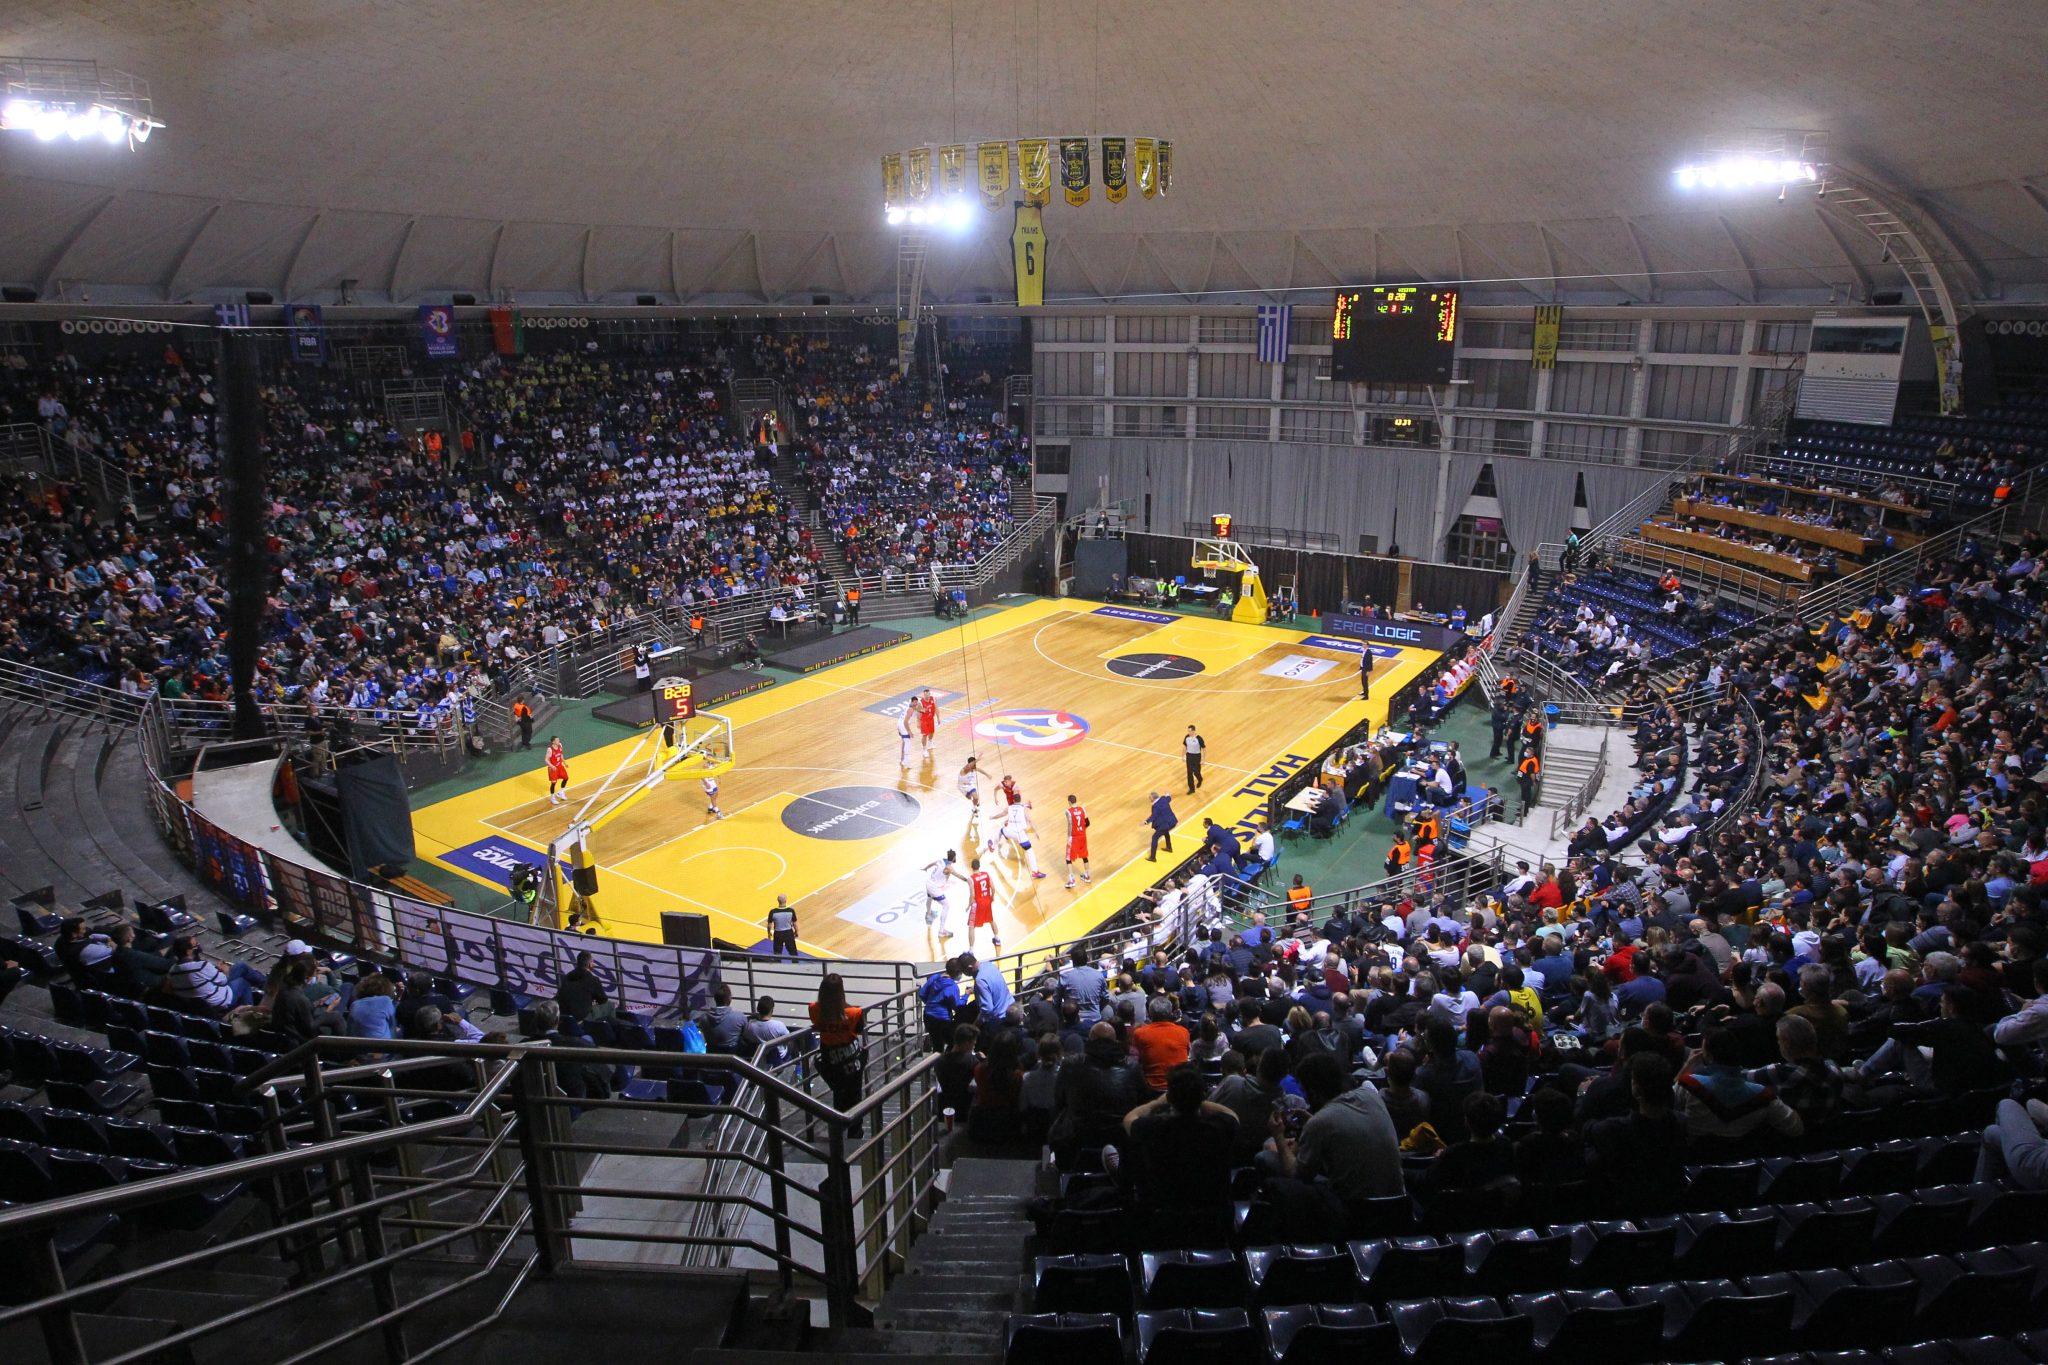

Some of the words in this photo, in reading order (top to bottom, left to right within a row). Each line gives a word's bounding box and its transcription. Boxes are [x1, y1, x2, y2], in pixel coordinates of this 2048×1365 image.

[1026, 241, 1034, 275] 6
[1377, 305, 1388, 313] 42
[1402, 305, 1413, 314] 34
[1220, 524, 1228, 536] 5
[1099, 609, 1158, 620] AEGEAN
[664, 684, 691, 700] 8:28
[676, 698, 688, 716] 5
[1232, 753, 1311, 798] HALL
[806, 799, 880, 834] EUROBANK
[1076, 815, 1082, 827] 7
[979, 880, 988, 892] 12
